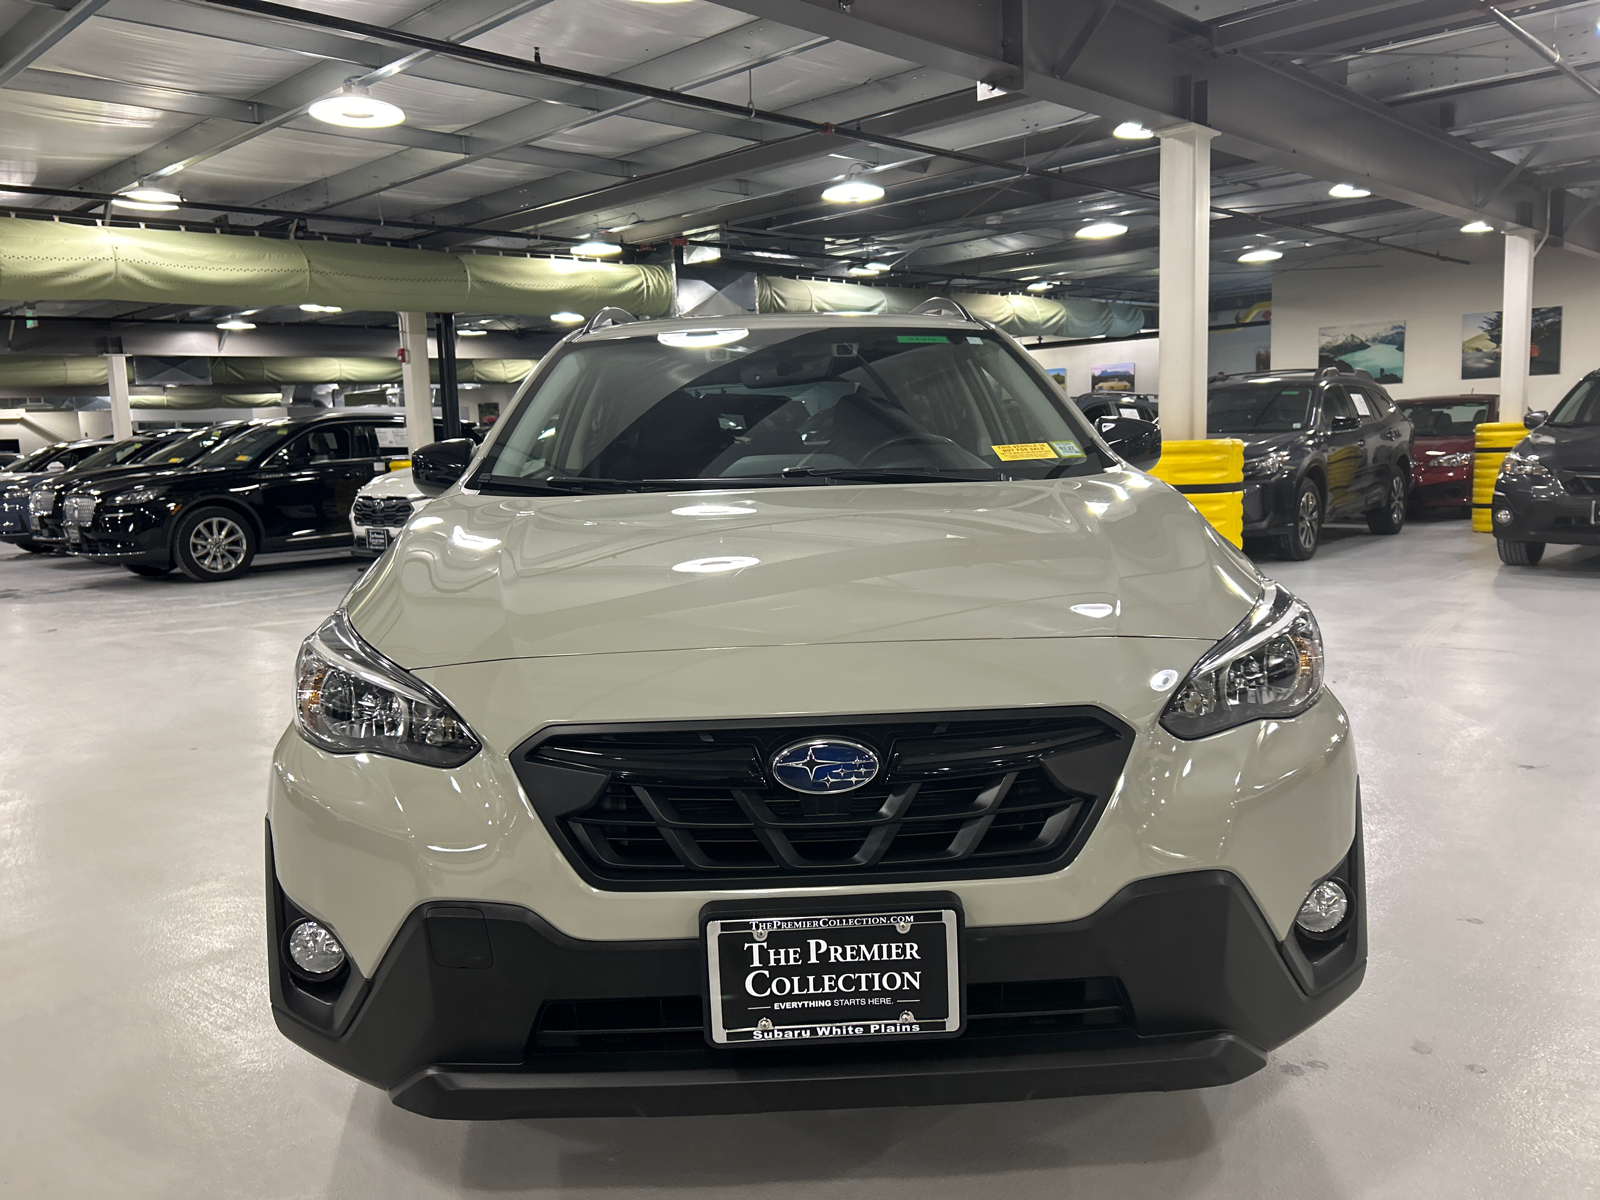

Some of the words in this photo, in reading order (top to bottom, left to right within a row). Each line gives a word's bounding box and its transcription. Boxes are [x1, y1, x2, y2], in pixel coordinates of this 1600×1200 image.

[749, 915, 914, 931] THEPREMIERCOLLECTION.COM
[743, 941, 802, 968] THE
[806, 939, 921, 964] PREMIER
[744, 970, 922, 998] COLLECTION
[773, 1000, 832, 1010] EVERYTHING
[833, 998, 866, 1007] STARTS
[867, 998, 894, 1006] HERE.
[752, 1029, 811, 1040] Subaru
[816, 1026, 864, 1036] White
[870, 1023, 920, 1034] Plains
